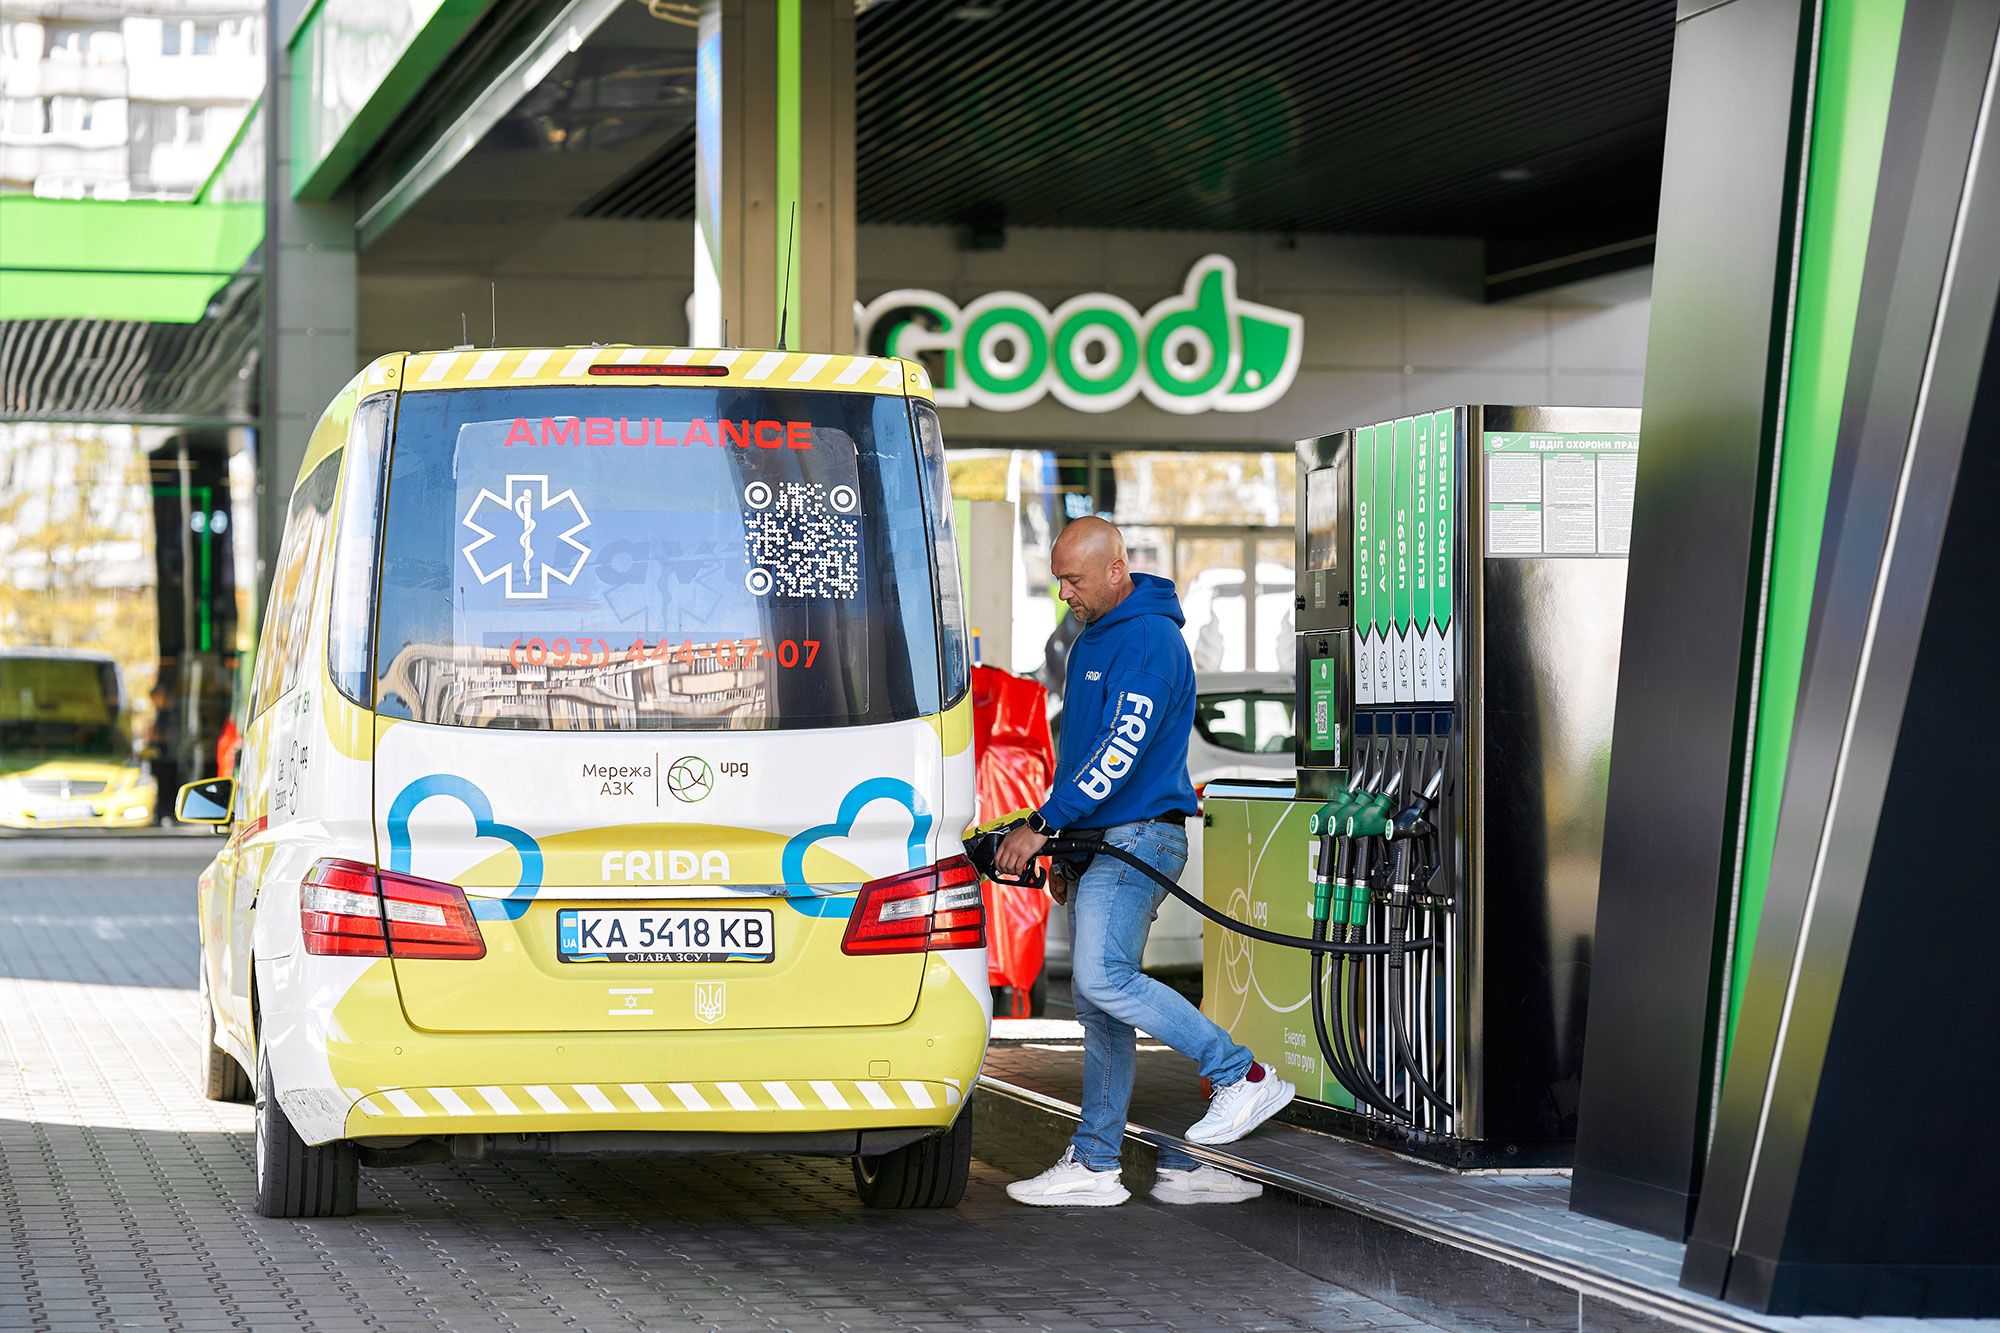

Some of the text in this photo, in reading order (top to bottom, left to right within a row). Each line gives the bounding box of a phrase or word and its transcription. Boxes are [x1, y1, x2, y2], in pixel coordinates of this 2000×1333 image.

[504, 417, 813, 450] AMBULANCE
[1529, 440, 1563, 450] ВІДДІЛ
[1565, 440, 1611, 449] ОХОРОНИ
[1418, 427, 1427, 589] EURO DIESEL
[1438, 423, 1447, 588] EURO DIESEL
[1360, 501, 1368, 596] upg100
[1397, 508, 1406, 589] upg95
[508, 637, 821, 670] (093) 444-07-07
[1077, 692, 1154, 800] FRIDA
[582, 763, 652, 779] Мережа
[720, 761, 749, 777] upg
[600, 782, 634, 796] АЗК
[601, 850, 730, 881] FRIDA
[1253, 901, 1268, 926] upg
[563, 939, 577, 948] UA
[581, 918, 764, 948] KA 5418 KB
[624, 952, 673, 963] СЛАВА
[1284, 1027, 1307, 1049] Енергія
[1285, 1051, 1315, 1073] твого руху
